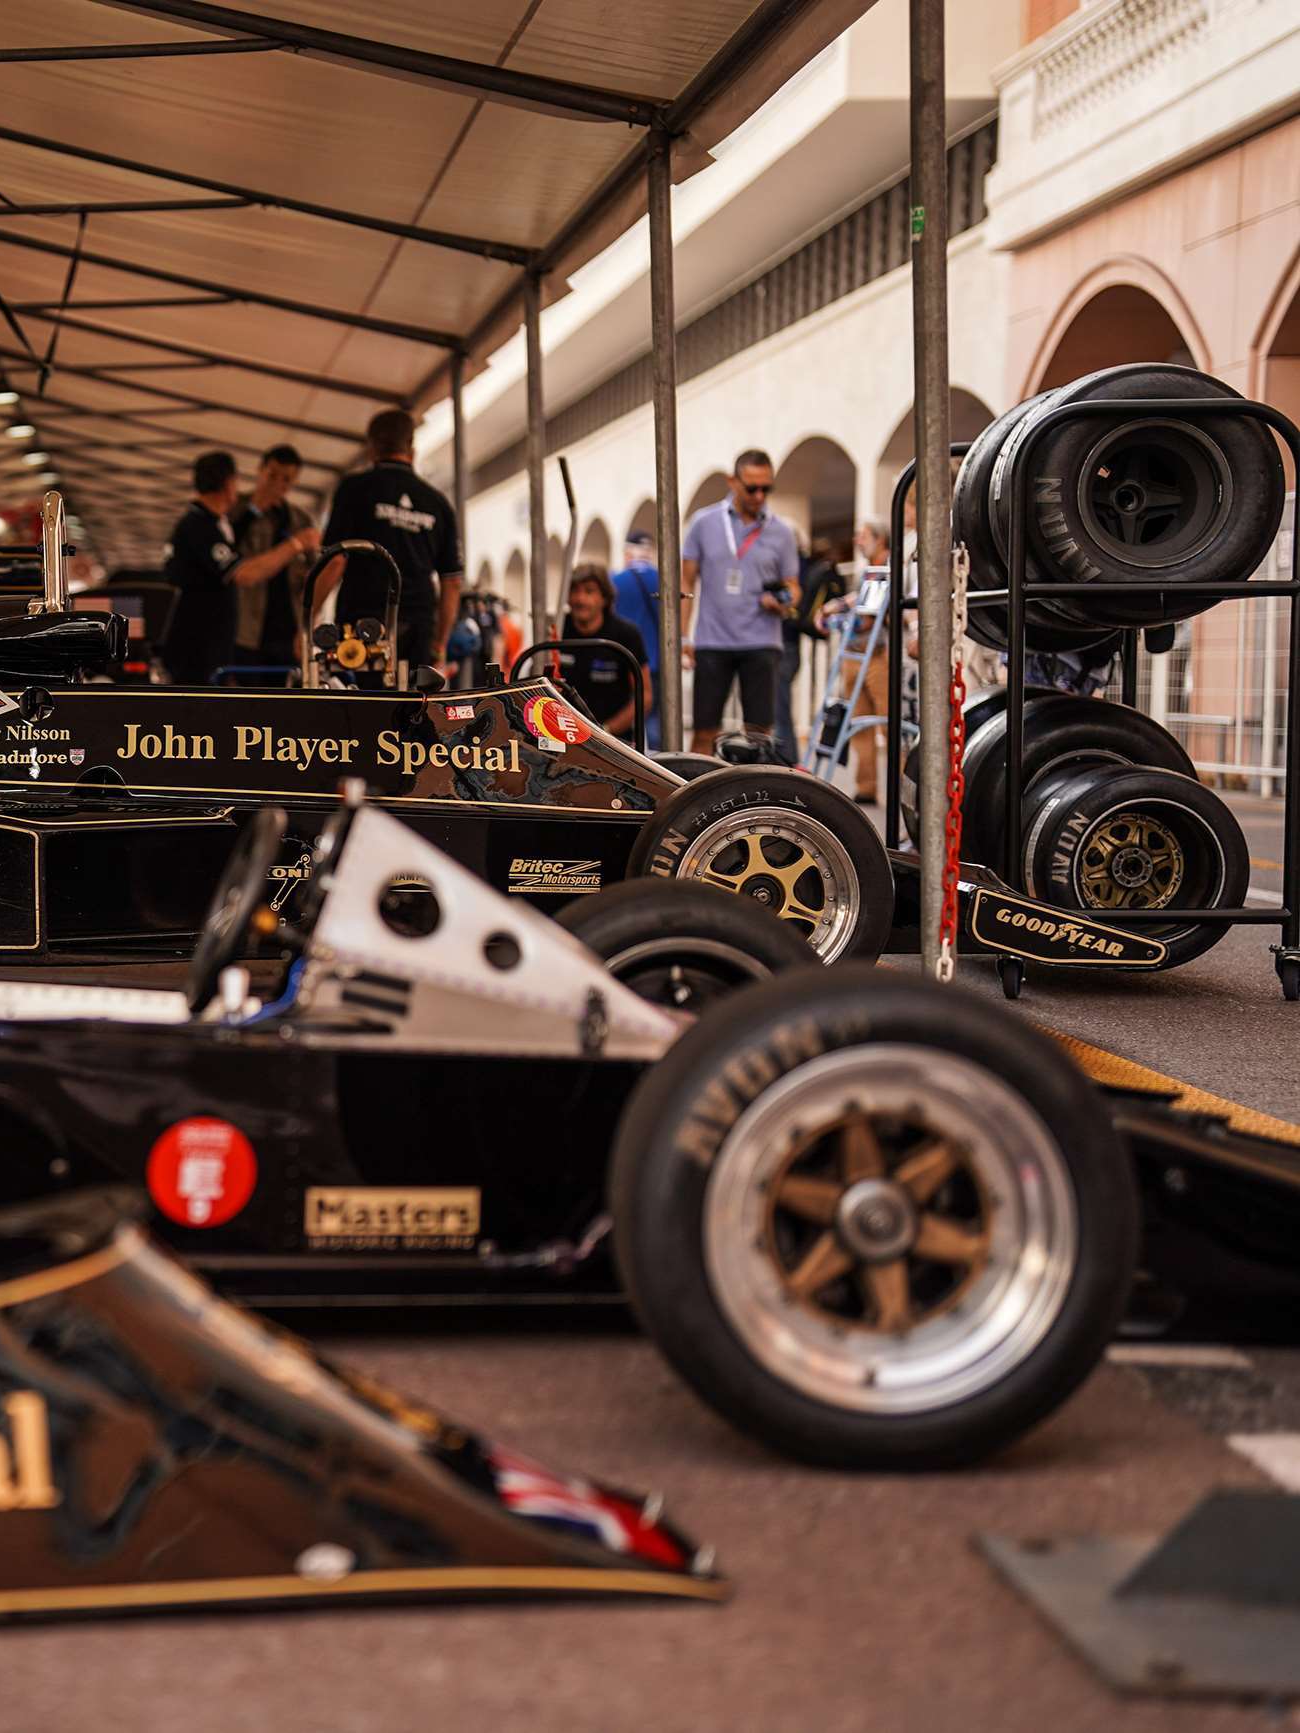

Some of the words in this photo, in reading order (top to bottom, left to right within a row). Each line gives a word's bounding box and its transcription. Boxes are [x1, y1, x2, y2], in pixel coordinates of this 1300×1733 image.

[557, 715, 580, 733] E
[6, 725, 71, 741] Nilsson
[565, 731, 577, 743] 6
[117, 723, 216, 761] John
[233, 725, 359, 771] Player
[377, 730, 522, 775] Special
[712, 798, 736, 814] SET
[1050, 812, 1090, 885] AVON
[269, 868, 310, 878] ONI
[508, 858, 564, 874] Britec
[541, 874, 601, 886] Motorsports
[995, 908, 1125, 958] GOODYEAR
